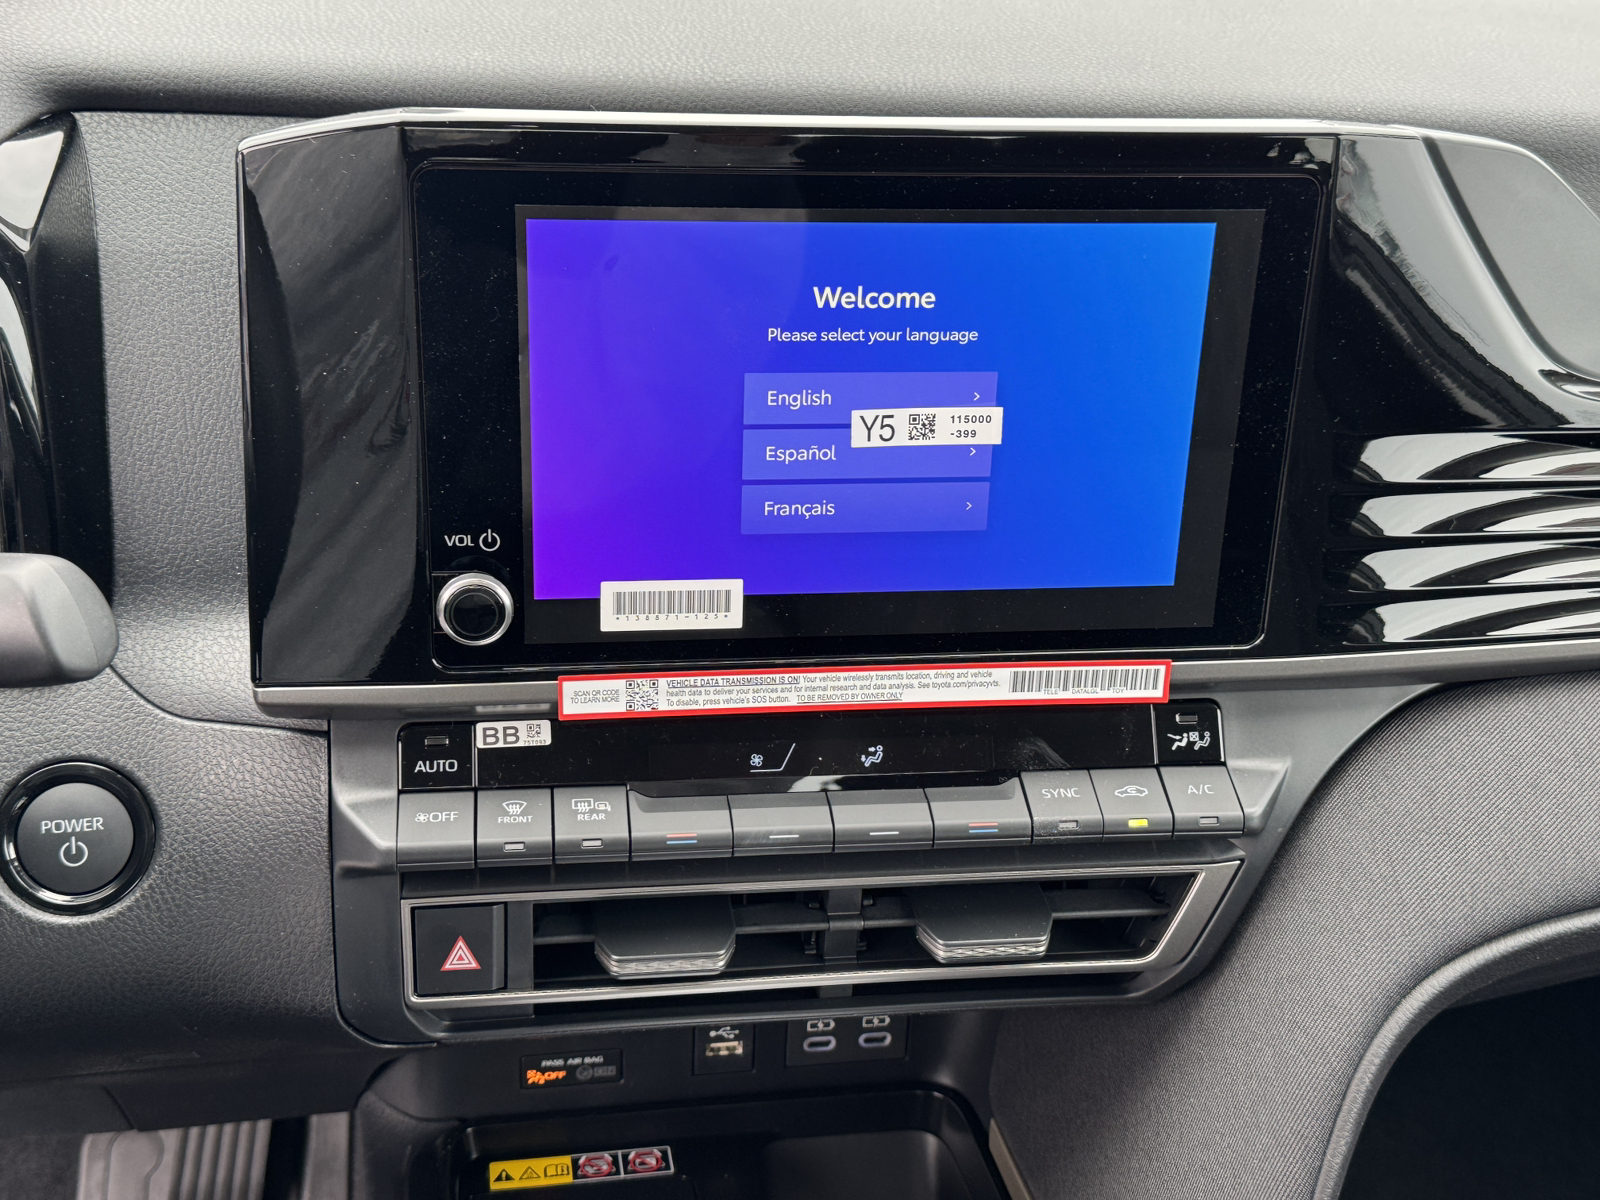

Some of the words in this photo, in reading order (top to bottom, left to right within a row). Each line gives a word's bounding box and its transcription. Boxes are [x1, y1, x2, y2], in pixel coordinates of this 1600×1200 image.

[812, 286, 936, 309] Welcome
[768, 328, 818, 342] Please
[820, 327, 865, 342] select
[867, 330, 902, 345] your
[906, 327, 979, 344] language
[767, 390, 832, 410] English
[950, 414, 992, 424] 115000
[859, 414, 896, 442] Y5
[950, 429, 977, 438] -399
[766, 445, 837, 464] Español
[764, 500, 835, 520] Français
[444, 534, 475, 546] VOL
[666, 679, 698, 687] VEHICLE
[700, 678, 719, 686] DATA
[720, 676, 777, 686] TRANSMISSION
[778, 676, 786, 684] IS
[788, 676, 800, 684] ON!
[802, 675, 817, 683] Your
[818, 674, 841, 682] vehicle
[843, 673, 874, 682] wirelessly
[875, 672, 904, 680] transmits
[906, 672, 932, 680] location,
[934, 671, 954, 680] driving
[956, 670, 968, 678] and
[970, 670, 992, 678] vehicle
[666, 689, 686, 697] health
[736, 688, 750, 696] your
[752, 686, 778, 694] services
[804, 684, 828, 692] internal
[830, 684, 858, 692] research
[888, 682, 916, 690] analysis.
[666, 698, 674, 706] To
[676, 698, 701, 706] disable,
[702, 699, 720, 707] press
[722, 696, 750, 704] vehicle's
[752, 696, 767, 704] SOS
[817, 694, 850, 702] REMOVED
[860, 692, 886, 700] OWNER
[482, 726, 520, 746] BB
[414, 759, 458, 773] AUTO
[1042, 787, 1081, 798] SYNC
[1188, 784, 1214, 794] A/C
[429, 812, 459, 822] OFF
[498, 816, 533, 824] FRONT
[578, 813, 606, 821] REAR
[41, 816, 104, 834] POWER
[544, 1070, 567, 1080] OFF
